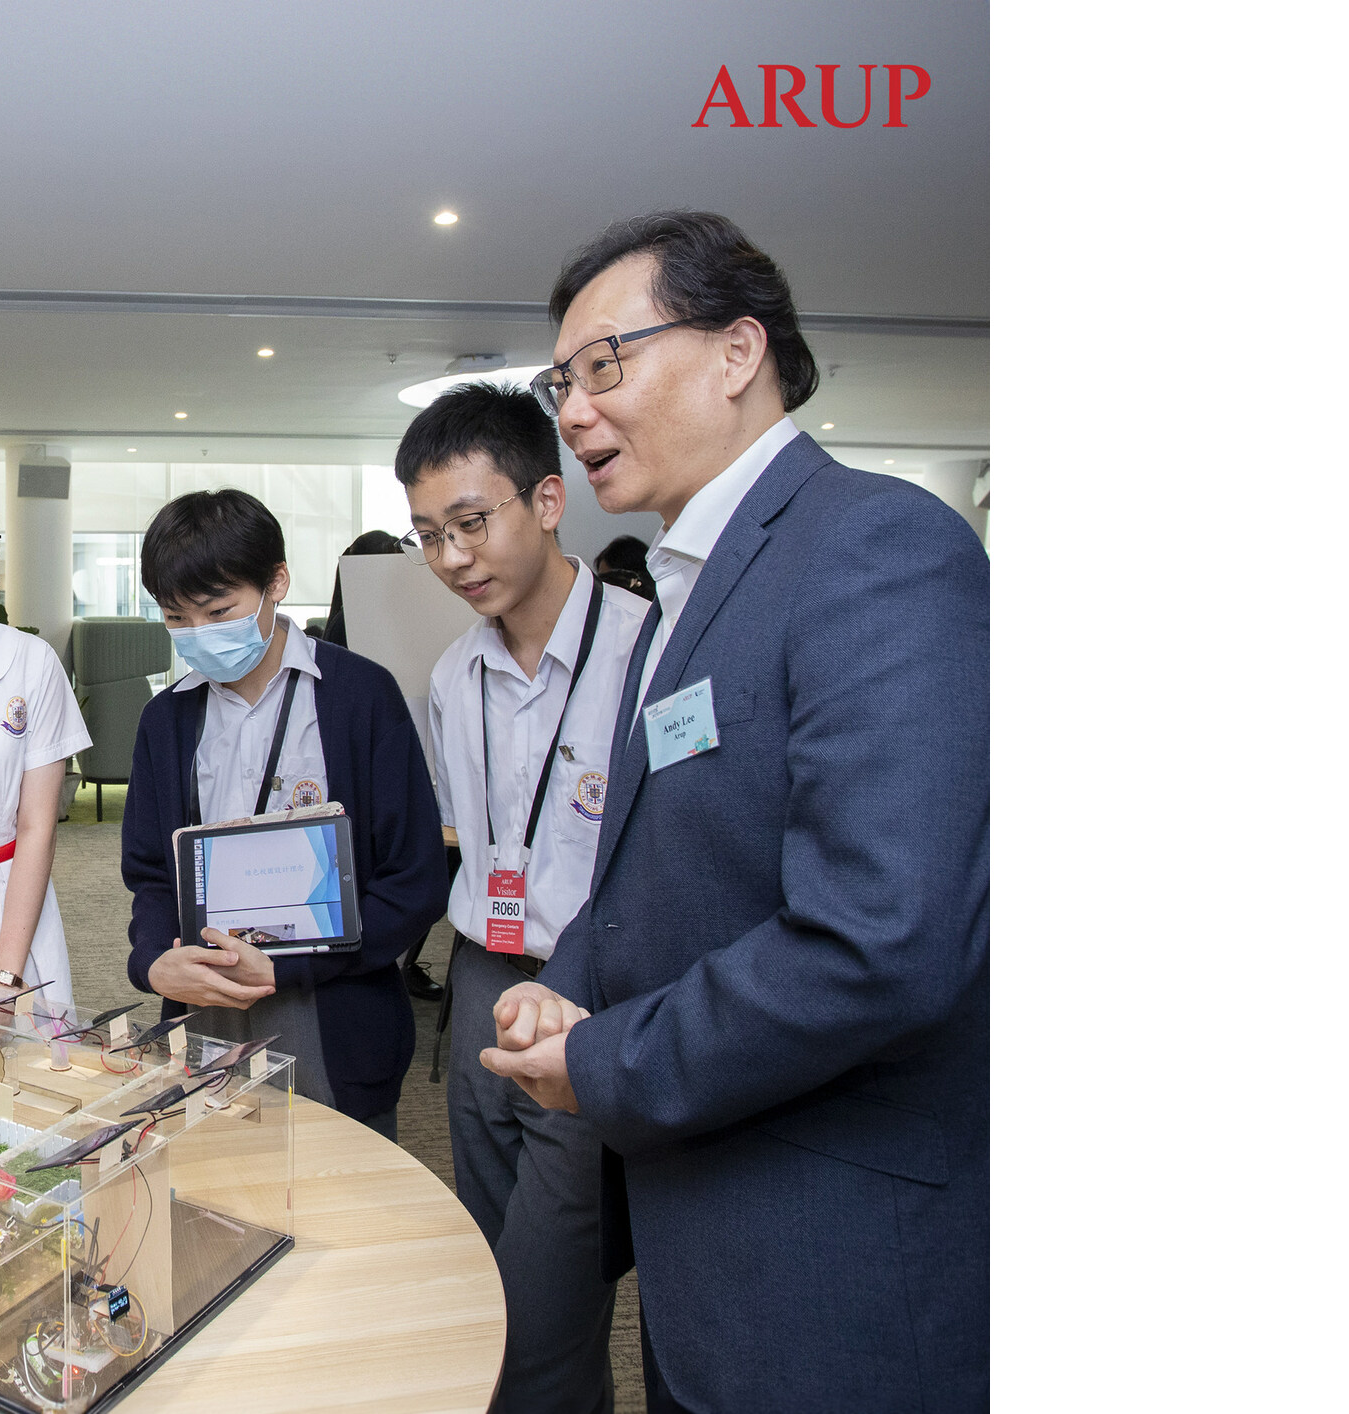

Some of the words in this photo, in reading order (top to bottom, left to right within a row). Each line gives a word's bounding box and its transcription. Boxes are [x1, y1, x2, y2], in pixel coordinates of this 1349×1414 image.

[663, 720, 681, 735] Andy
[682, 714, 696, 726] Lee
[674, 731, 687, 741] Arup
[496, 886, 517, 896] Visitor
[492, 901, 520, 917] R060
